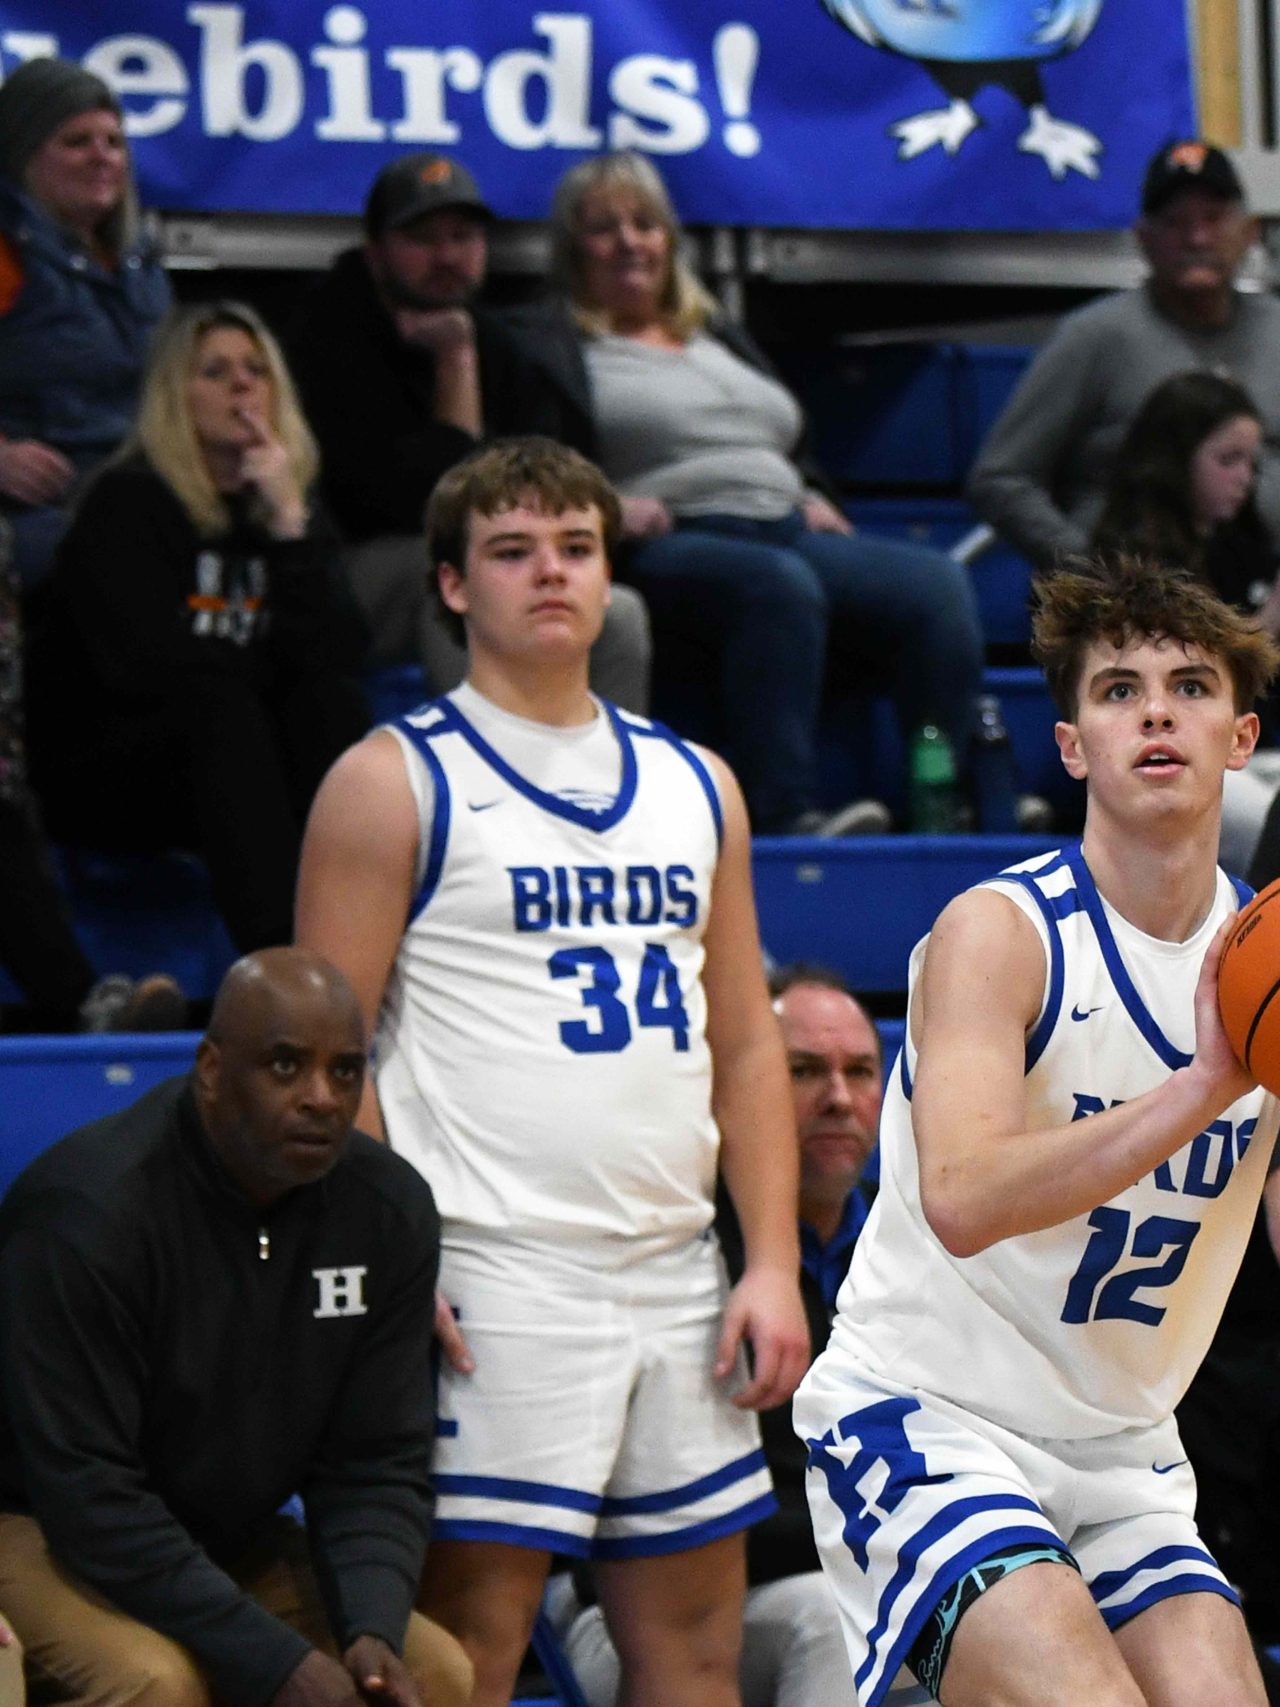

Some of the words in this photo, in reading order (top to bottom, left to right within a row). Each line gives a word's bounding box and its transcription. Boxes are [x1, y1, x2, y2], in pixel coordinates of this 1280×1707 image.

[0, 5, 761, 157] ebirds!
[505, 864, 699, 933] BIRDS
[546, 942, 689, 1054] 34
[313, 1266, 368, 1319] H
[1060, 1206, 1201, 1327] 12
[807, 1398, 955, 1574] H
